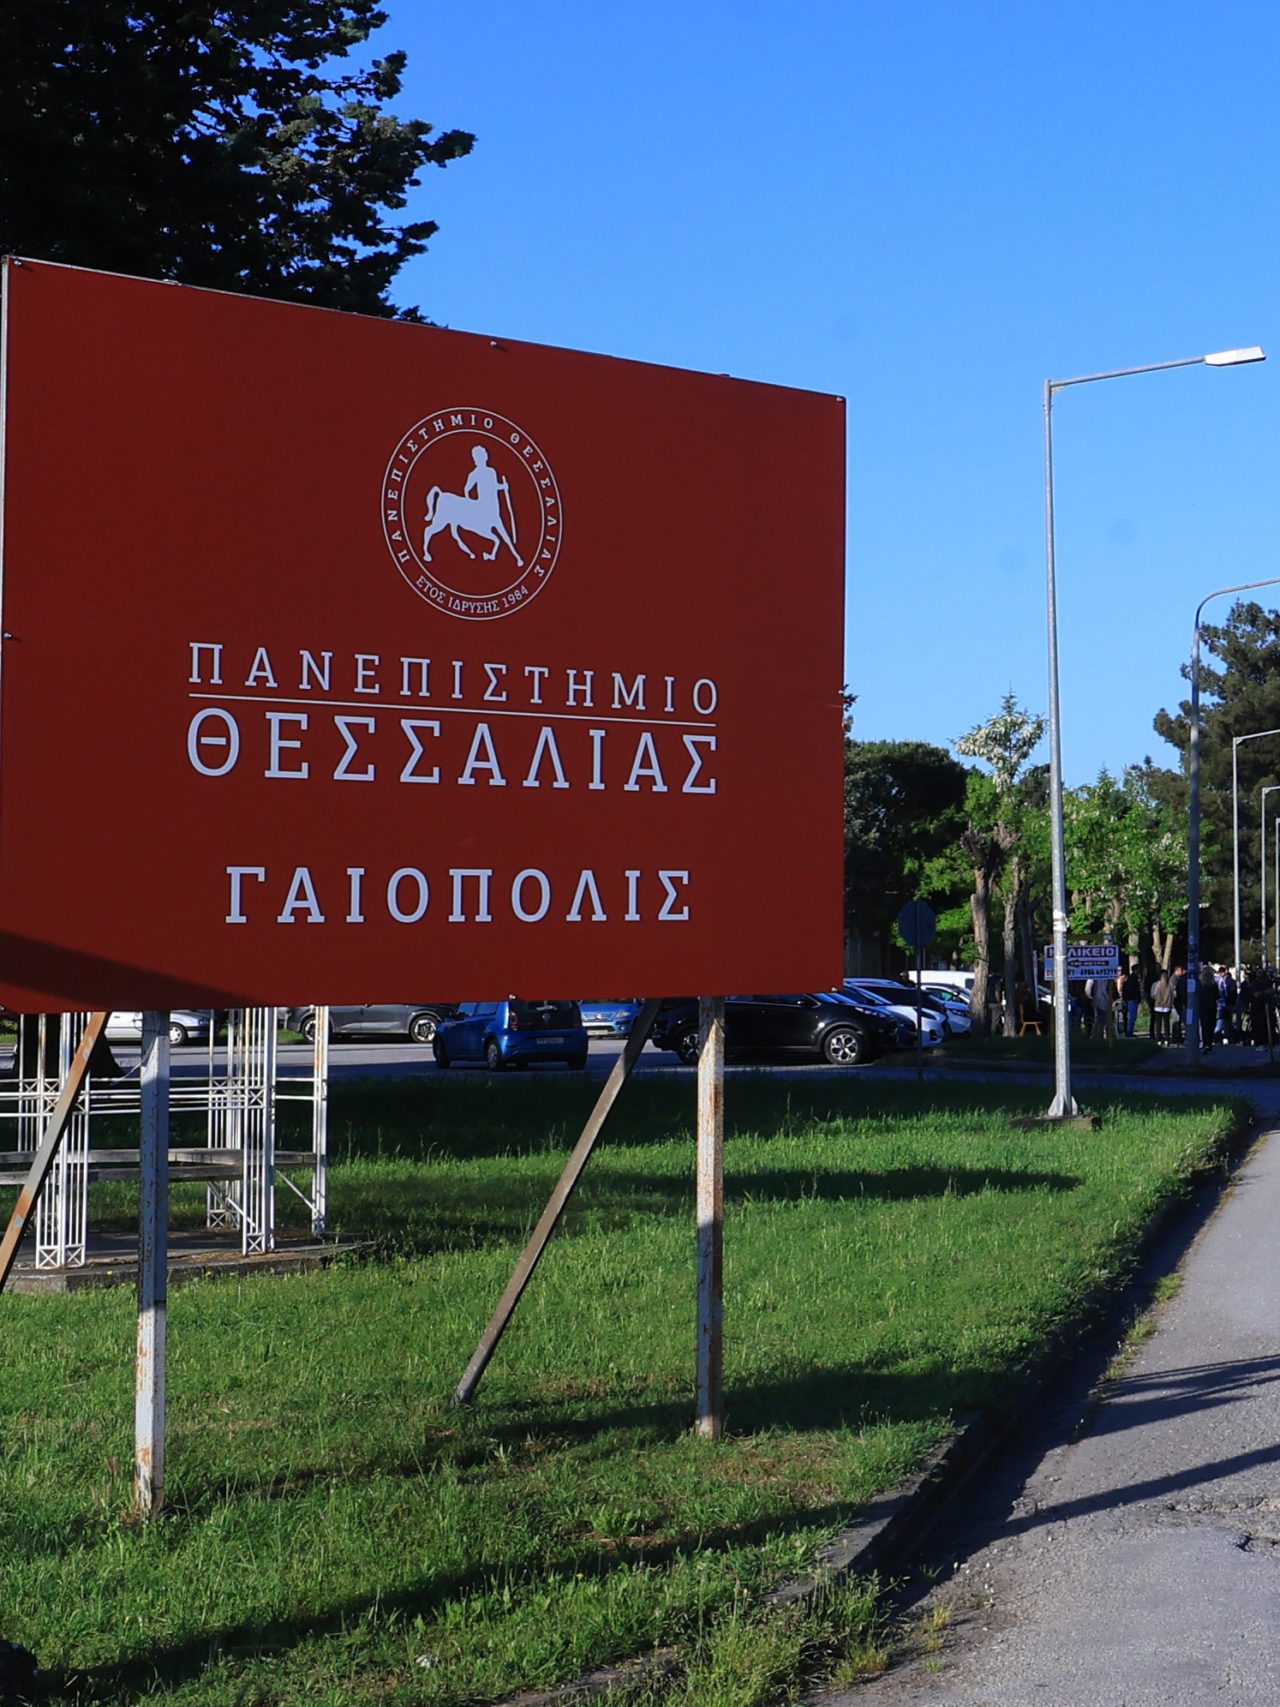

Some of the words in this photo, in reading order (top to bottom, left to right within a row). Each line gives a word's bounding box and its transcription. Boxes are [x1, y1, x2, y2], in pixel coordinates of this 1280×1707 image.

[387, 413, 494, 563] ΠΑΝΕΠΙΣΤΗΜΙΟ
[510, 432, 558, 577] ΘΕΣΣΑΛΙΑΣ
[416, 575, 446, 603] ΕΤΟΣ
[448, 596, 501, 614] ΙΔΡΥΣΗΣ
[502, 585, 529, 608] 1984
[188, 641, 718, 716] ΠΑΝΕΠΙΣΤΗΜΙΟ
[187, 707, 717, 795] ΘΕΣΣΑΛΙΑΣ
[225, 866, 690, 924] ΓΑΙΟΠΟΛΙΣ
[1048, 946, 1115, 957] ΚΛΙΚΕΙΟ
